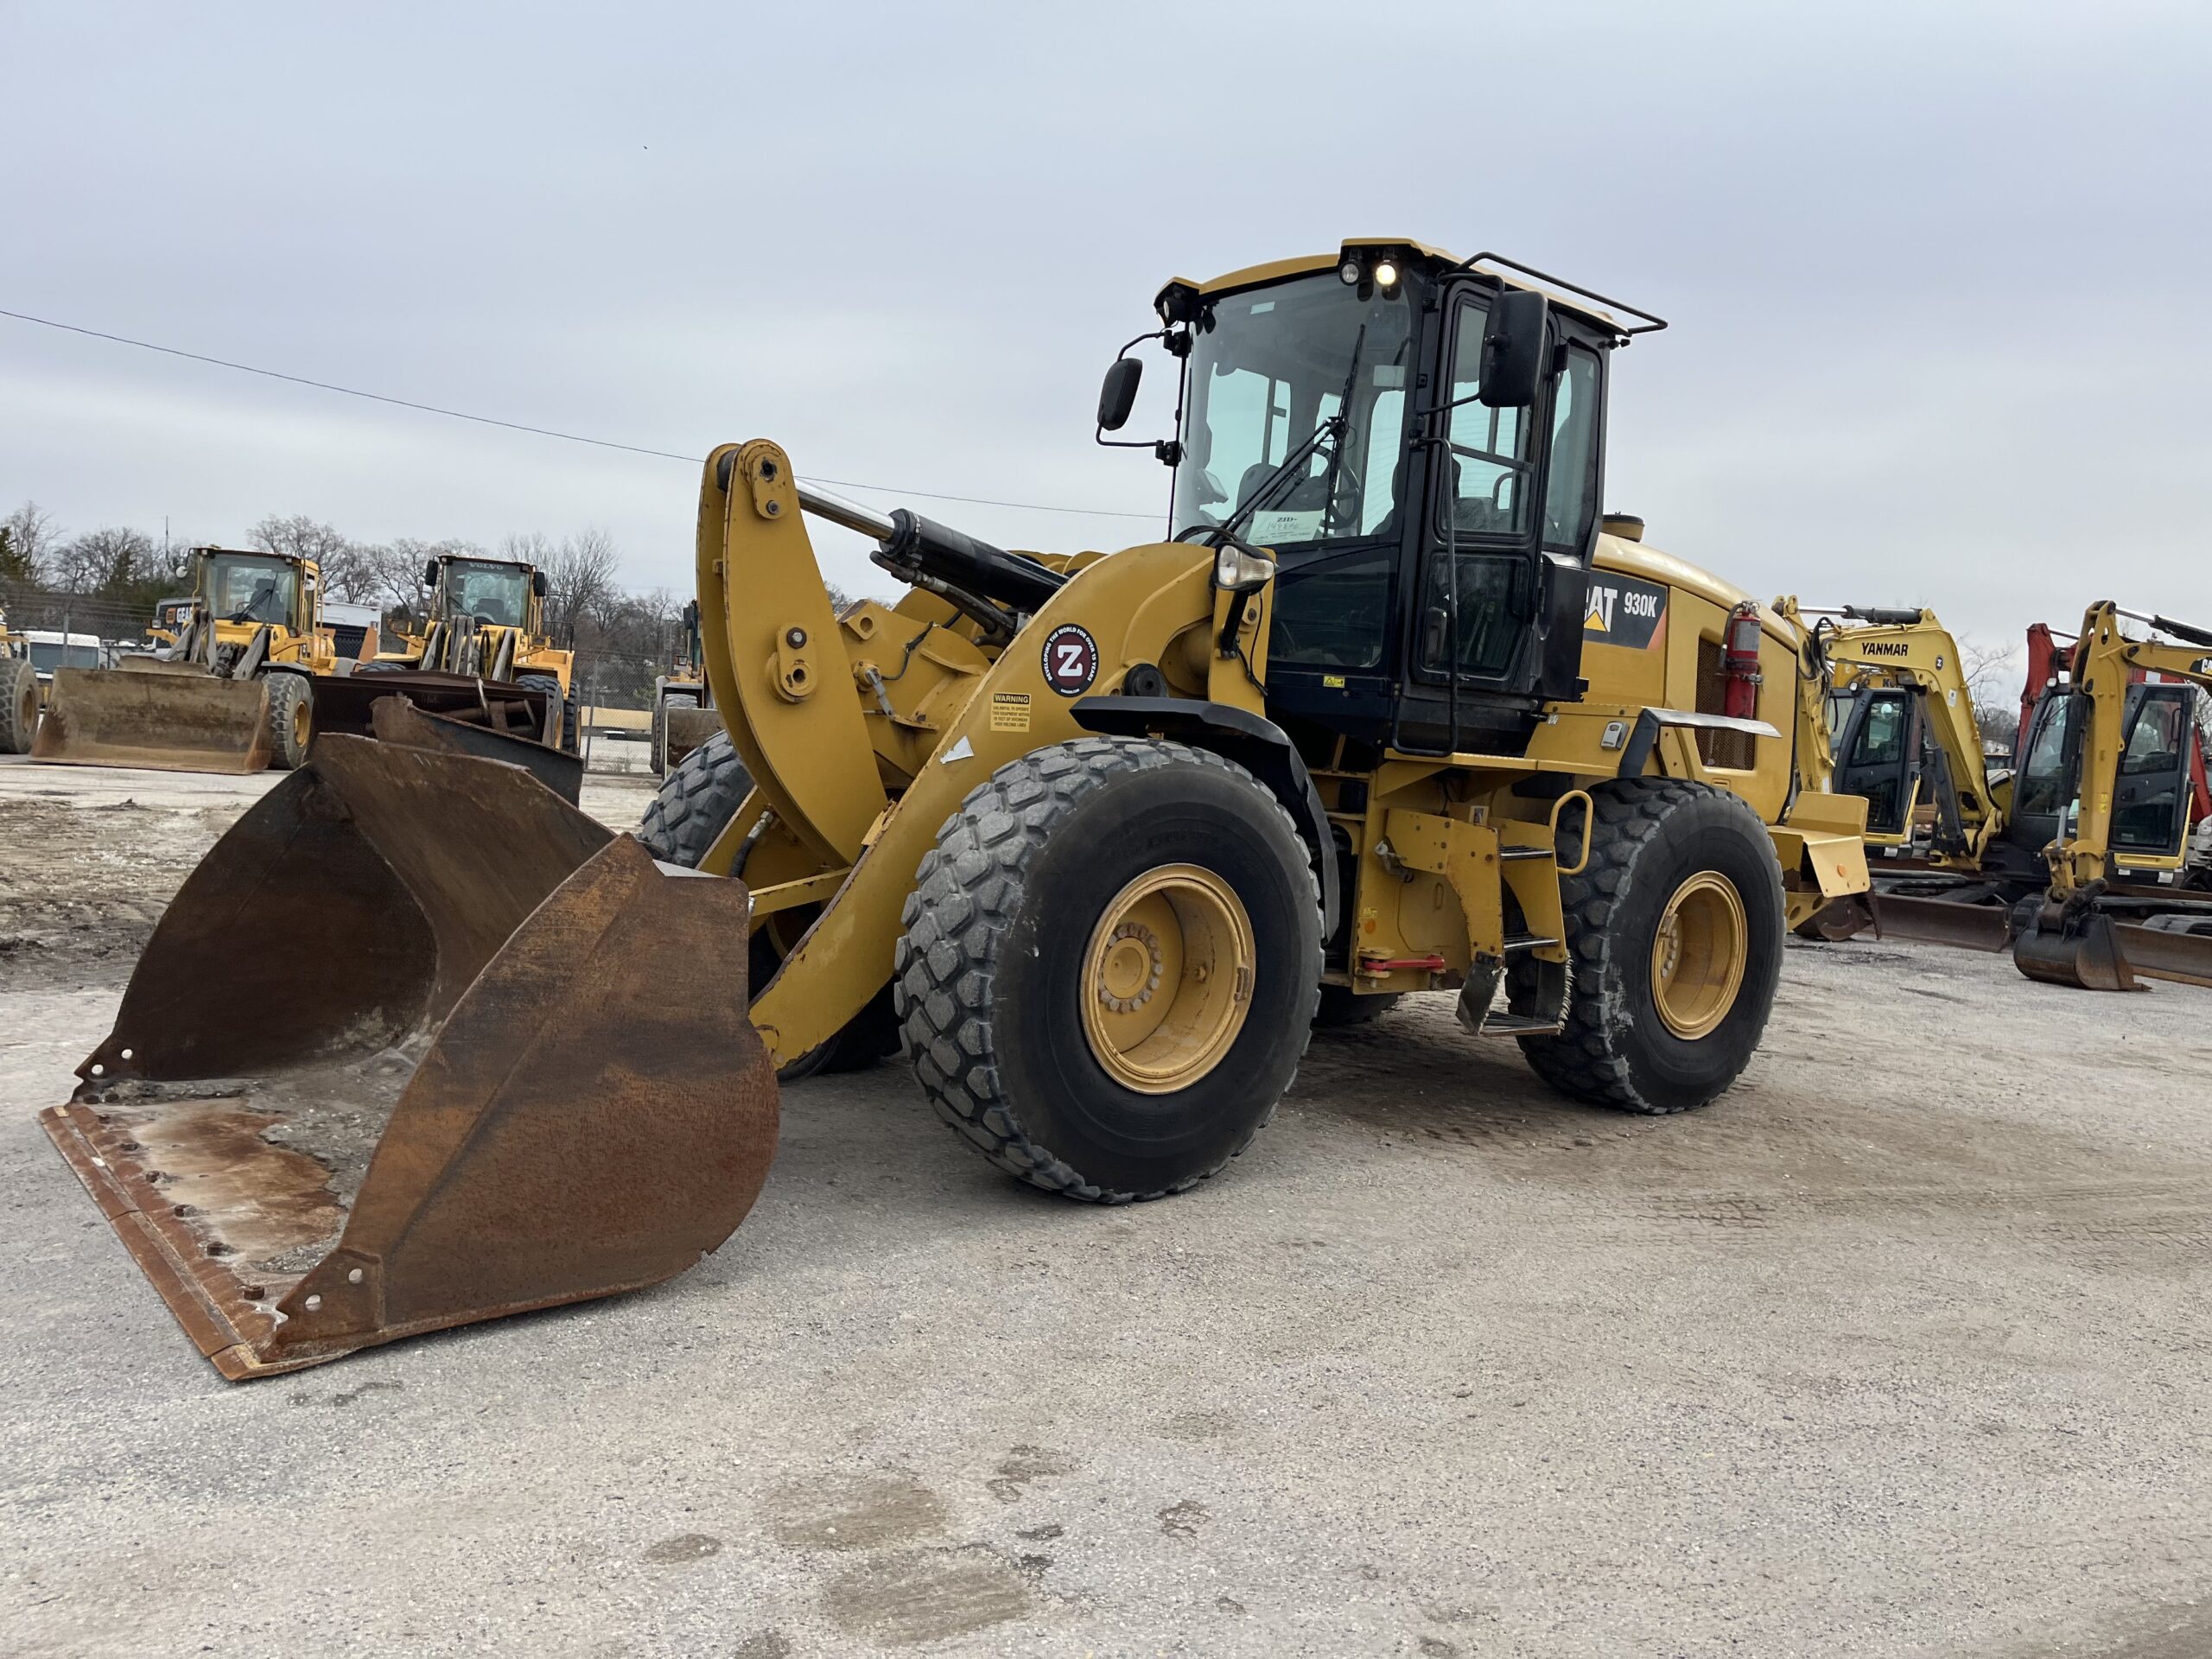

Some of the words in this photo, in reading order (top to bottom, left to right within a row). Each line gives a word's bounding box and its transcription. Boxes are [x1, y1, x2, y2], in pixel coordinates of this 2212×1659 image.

[468, 562, 504, 570] VOLVO
[1584, 586, 1618, 632] AT
[1624, 592, 1657, 618] 930K
[1049, 631, 1059, 643] THE
[1058, 626, 1077, 635] WORLD
[1077, 628, 1087, 639] FOR
[1085, 637, 1096, 653] OVER
[1862, 642, 1909, 657] YANMAR
[1043, 642, 1053, 681] DEVELOPING
[1057, 645, 1083, 677] Z
[1087, 661, 1096, 682] YEARS
[995, 694, 1029, 703] WARNING
